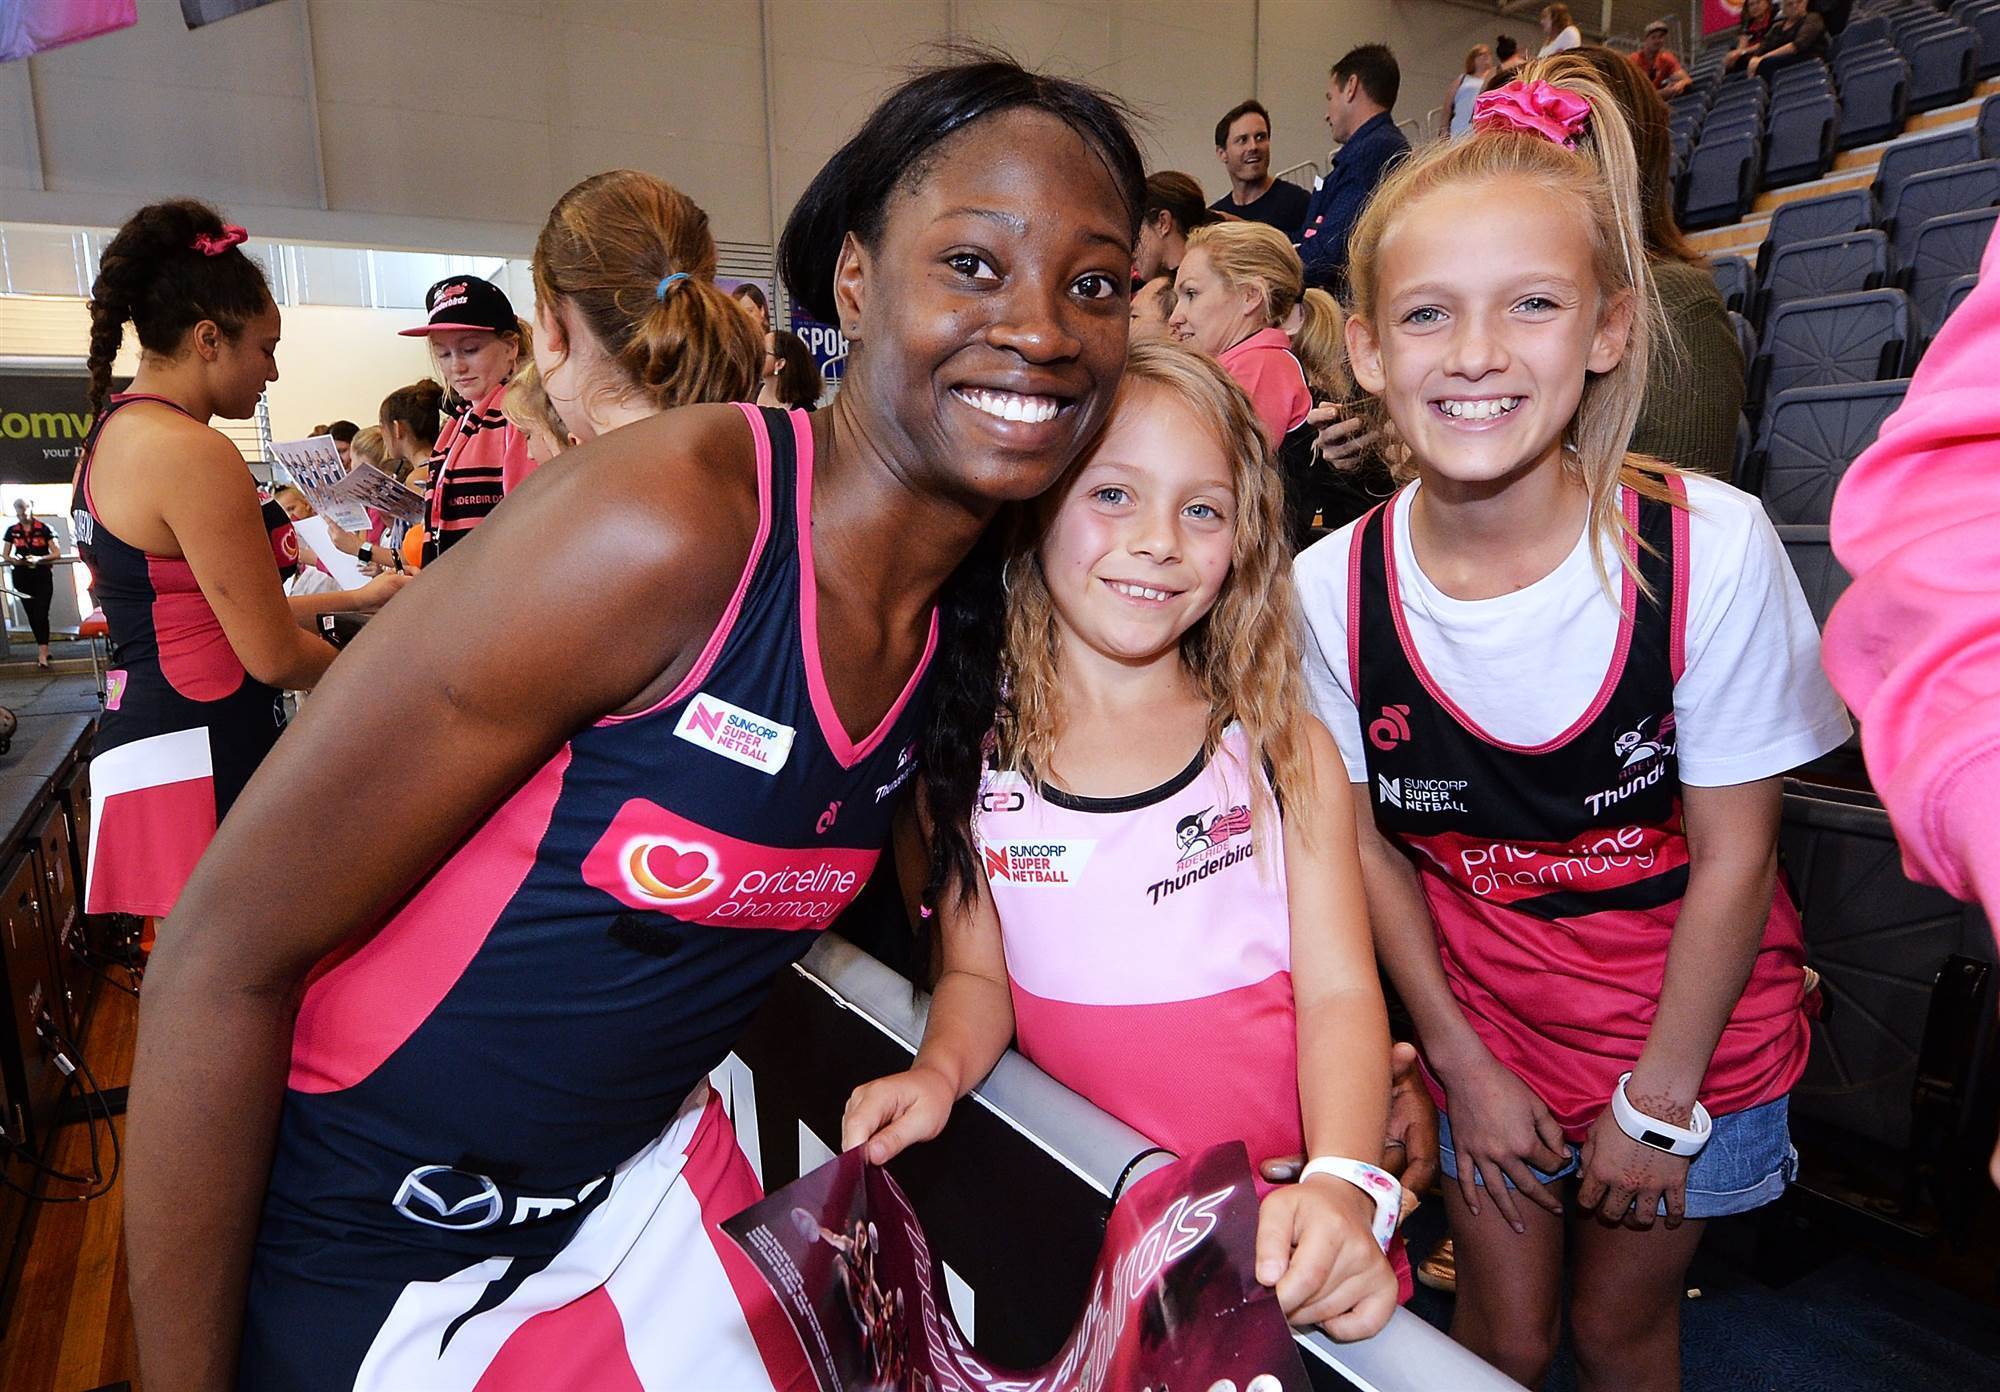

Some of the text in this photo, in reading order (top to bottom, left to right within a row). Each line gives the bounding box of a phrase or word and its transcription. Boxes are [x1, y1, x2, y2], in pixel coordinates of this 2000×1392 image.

[0, 411, 93, 440] omv
[42, 447, 71, 459] your
[722, 725, 762, 748] SUPER
[727, 713, 778, 740] SUNCORP
[716, 735, 768, 763] NETBALL
[1404, 778, 1468, 792] SUNCORP
[1405, 789, 1450, 801] SUPER
[1405, 801, 1468, 813] NETBALL
[1010, 845, 1066, 858] SUNCORP
[1177, 842, 1229, 873] ADELAIDE
[1011, 858, 1050, 870] SUPER
[1147, 843, 1258, 905] Thunderbird
[730, 863, 855, 897] priceline
[1013, 871, 1068, 883] NETBALL
[707, 899, 841, 922] pharmacy
